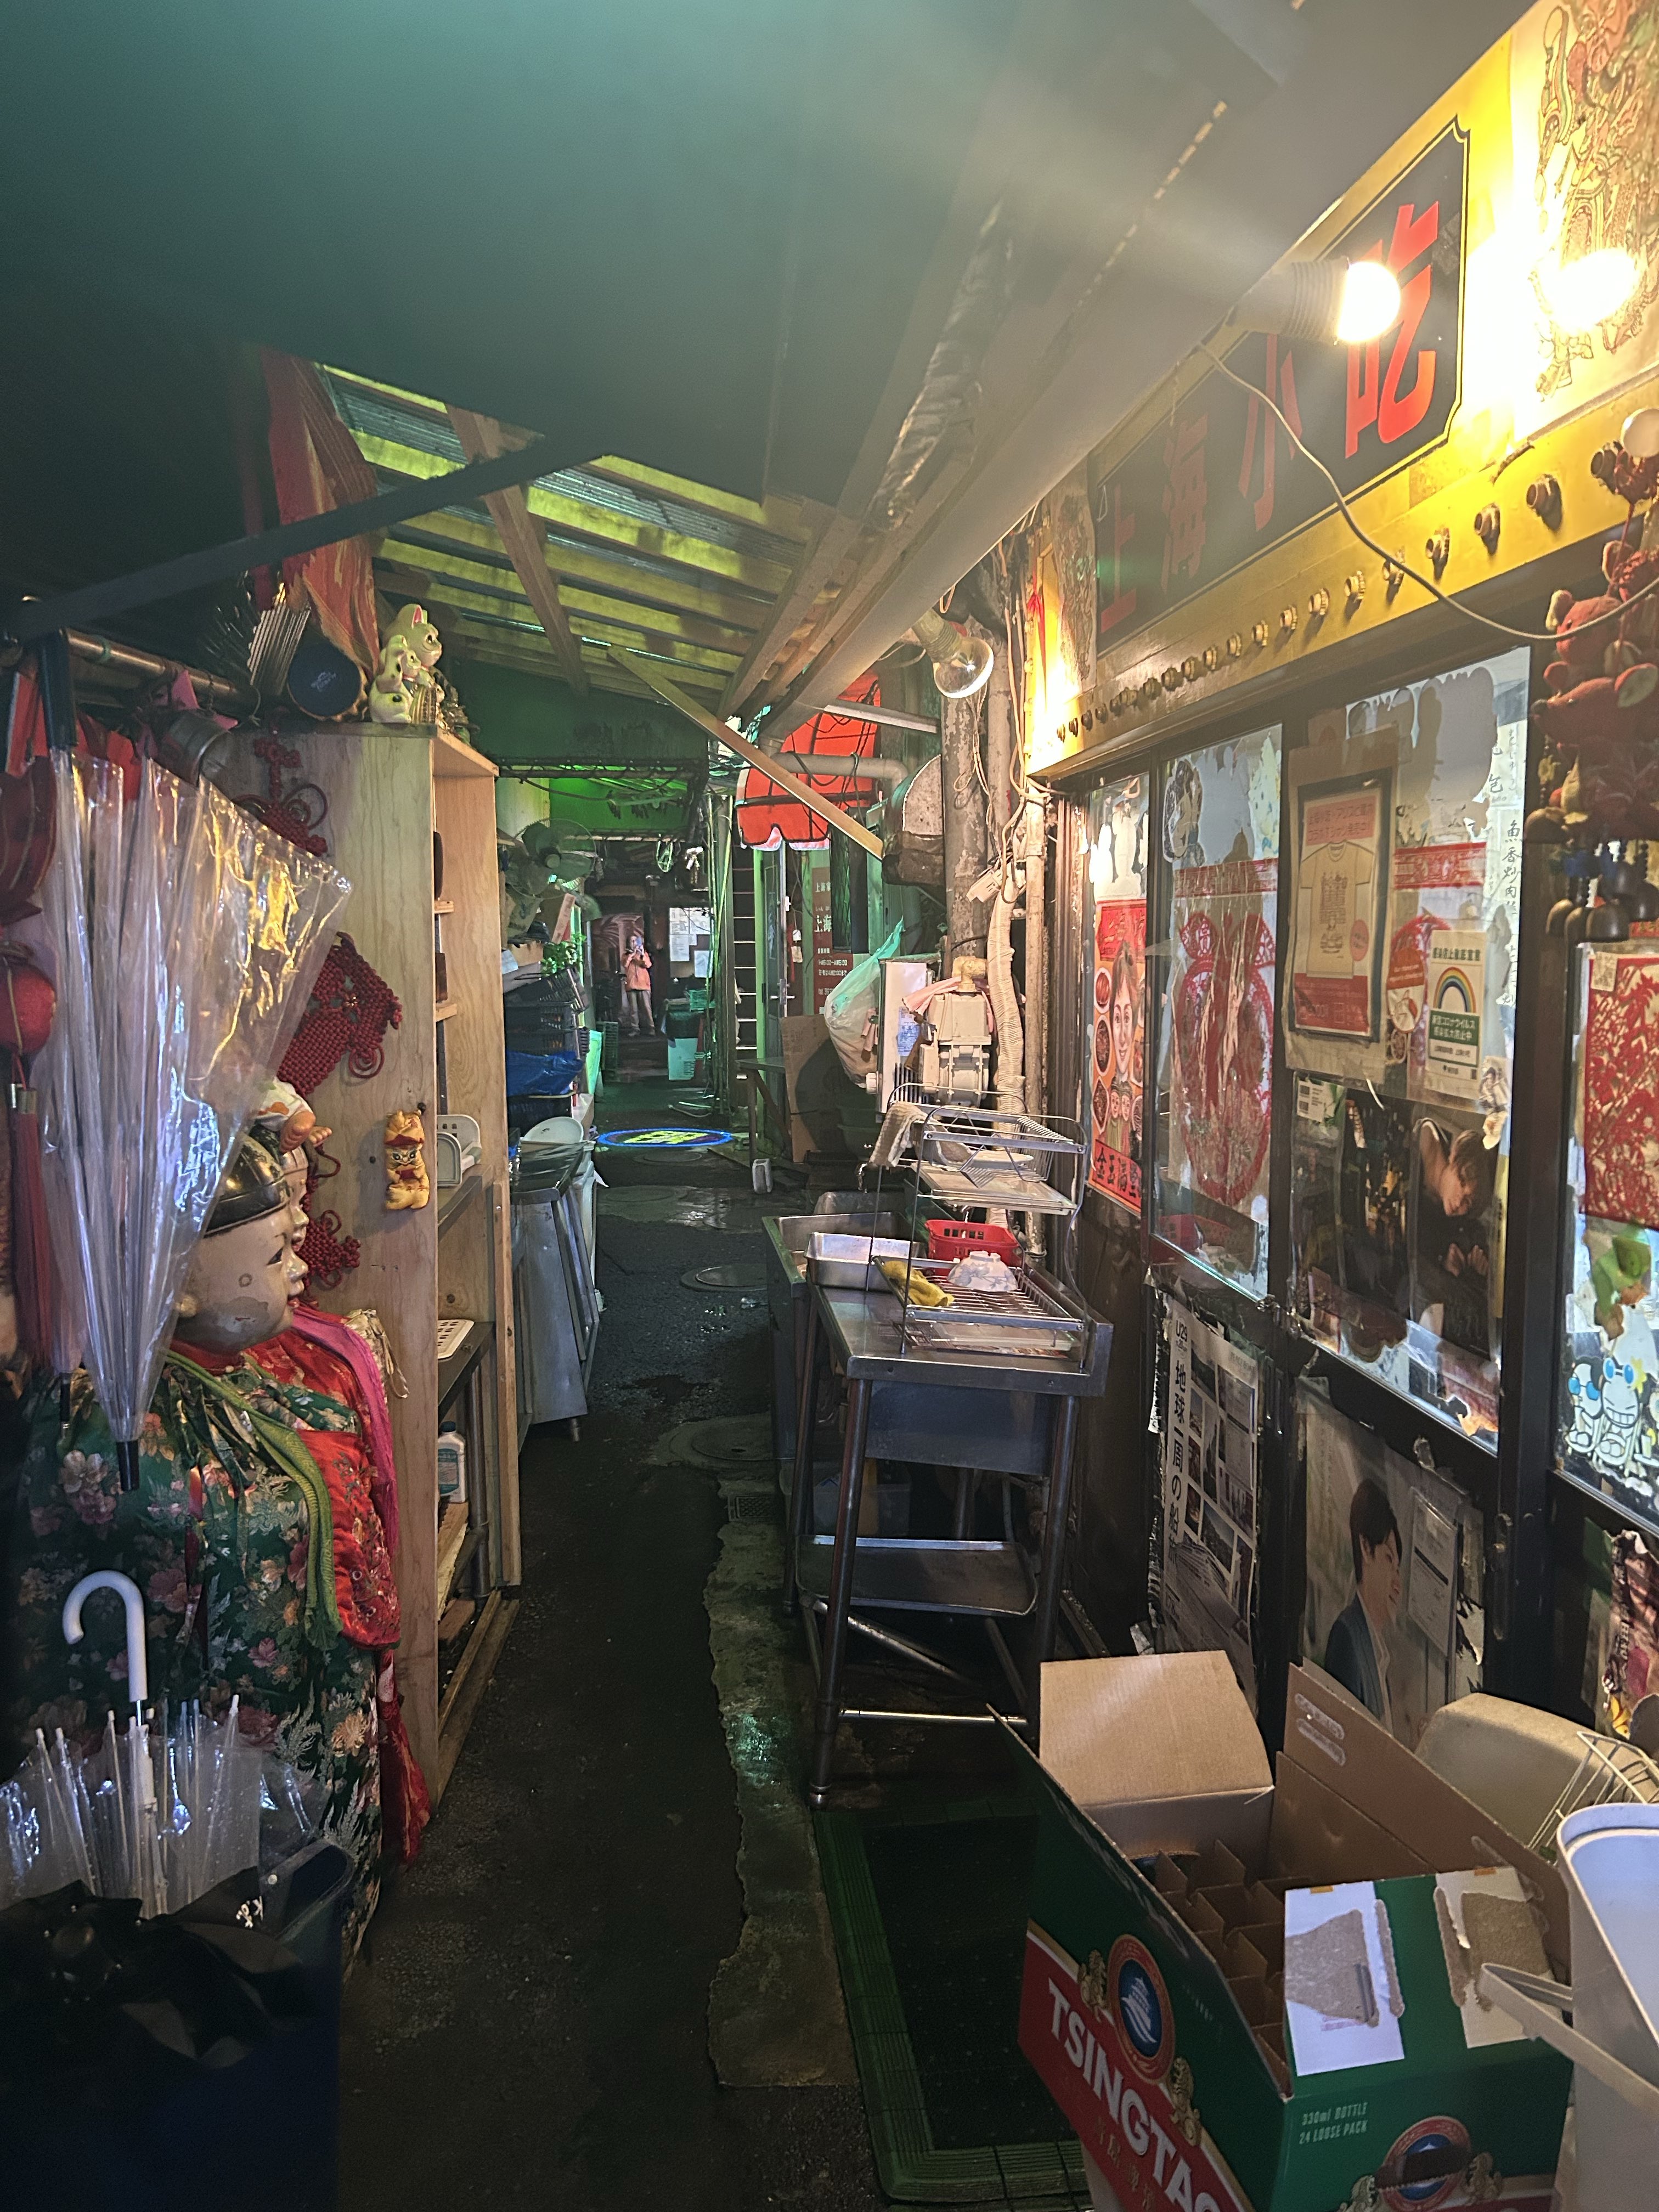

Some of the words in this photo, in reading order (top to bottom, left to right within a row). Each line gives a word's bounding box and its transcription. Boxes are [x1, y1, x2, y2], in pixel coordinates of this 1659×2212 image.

[1101, 201, 1438, 633] 上海小吃
[1334, 2102, 1368, 2120] BOTTLE
[1299, 2131, 1311, 2145] 24
[1313, 2124, 1341, 2142] LOOSE
[1343, 2119, 1368, 2136] PACK
